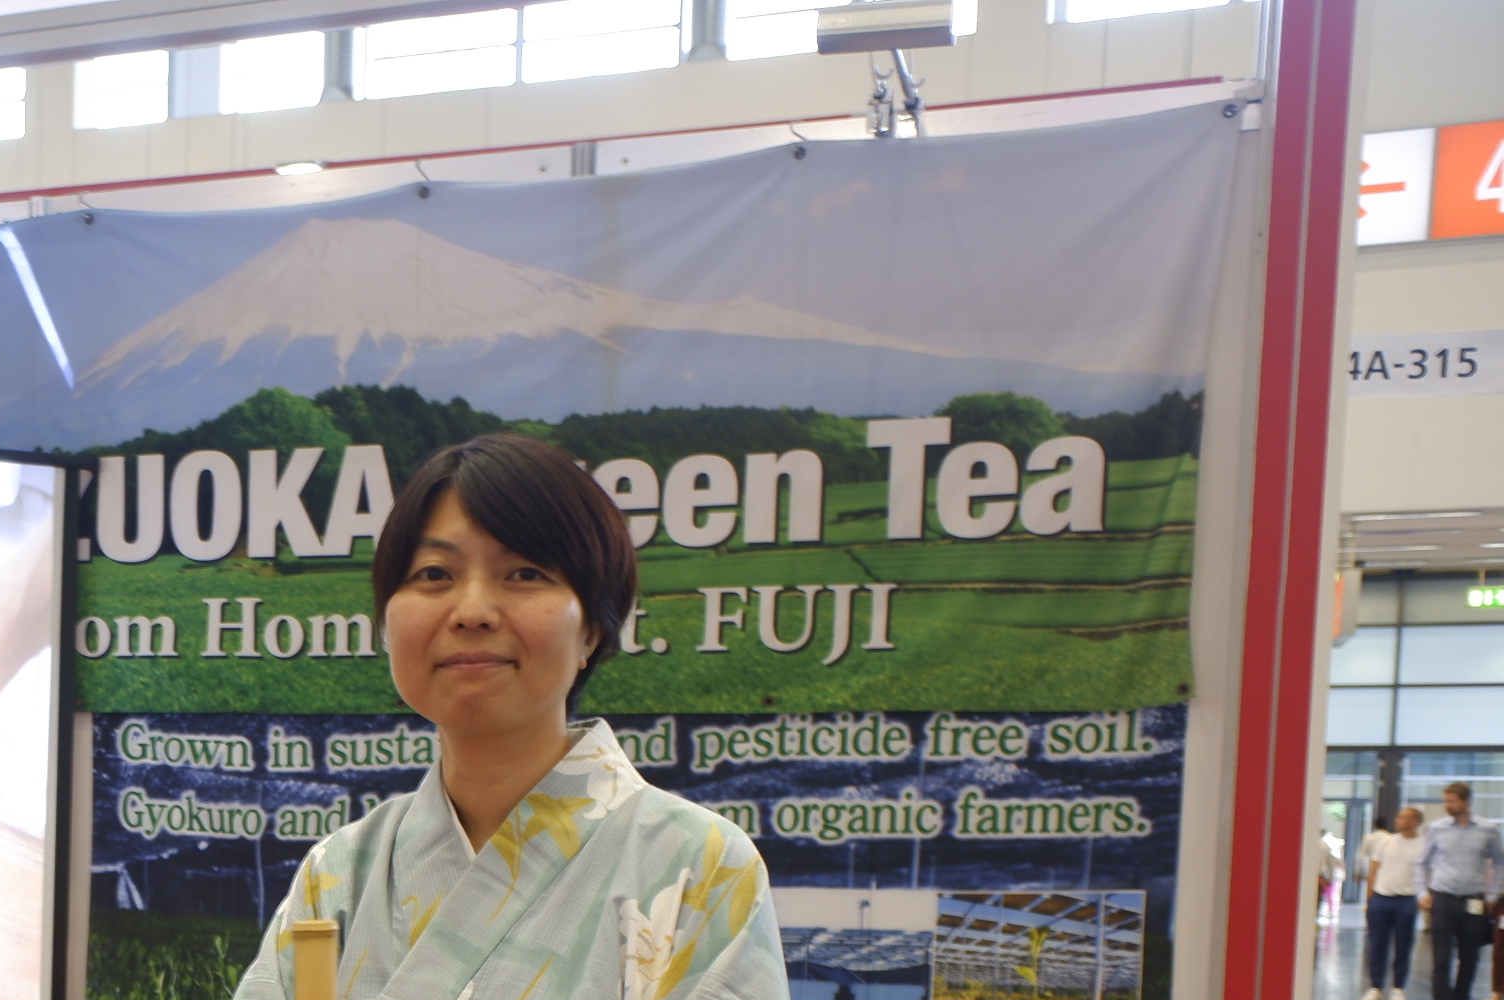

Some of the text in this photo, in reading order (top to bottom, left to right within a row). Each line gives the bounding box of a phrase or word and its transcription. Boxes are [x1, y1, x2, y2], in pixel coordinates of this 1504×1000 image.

[867, 417, 1107, 540] Tea
[697, 583, 896, 666] FUJI
[120, 722, 251, 768] Grown
[271, 729, 310, 767] in
[695, 711, 907, 769] pesticide
[928, 713, 1024, 757] free
[1047, 710, 1153, 754] soil.
[121, 791, 263, 838] Gyokuro
[279, 795, 348, 836] and
[776, 792, 939, 841] organic
[958, 791, 1149, 834] farmers.
